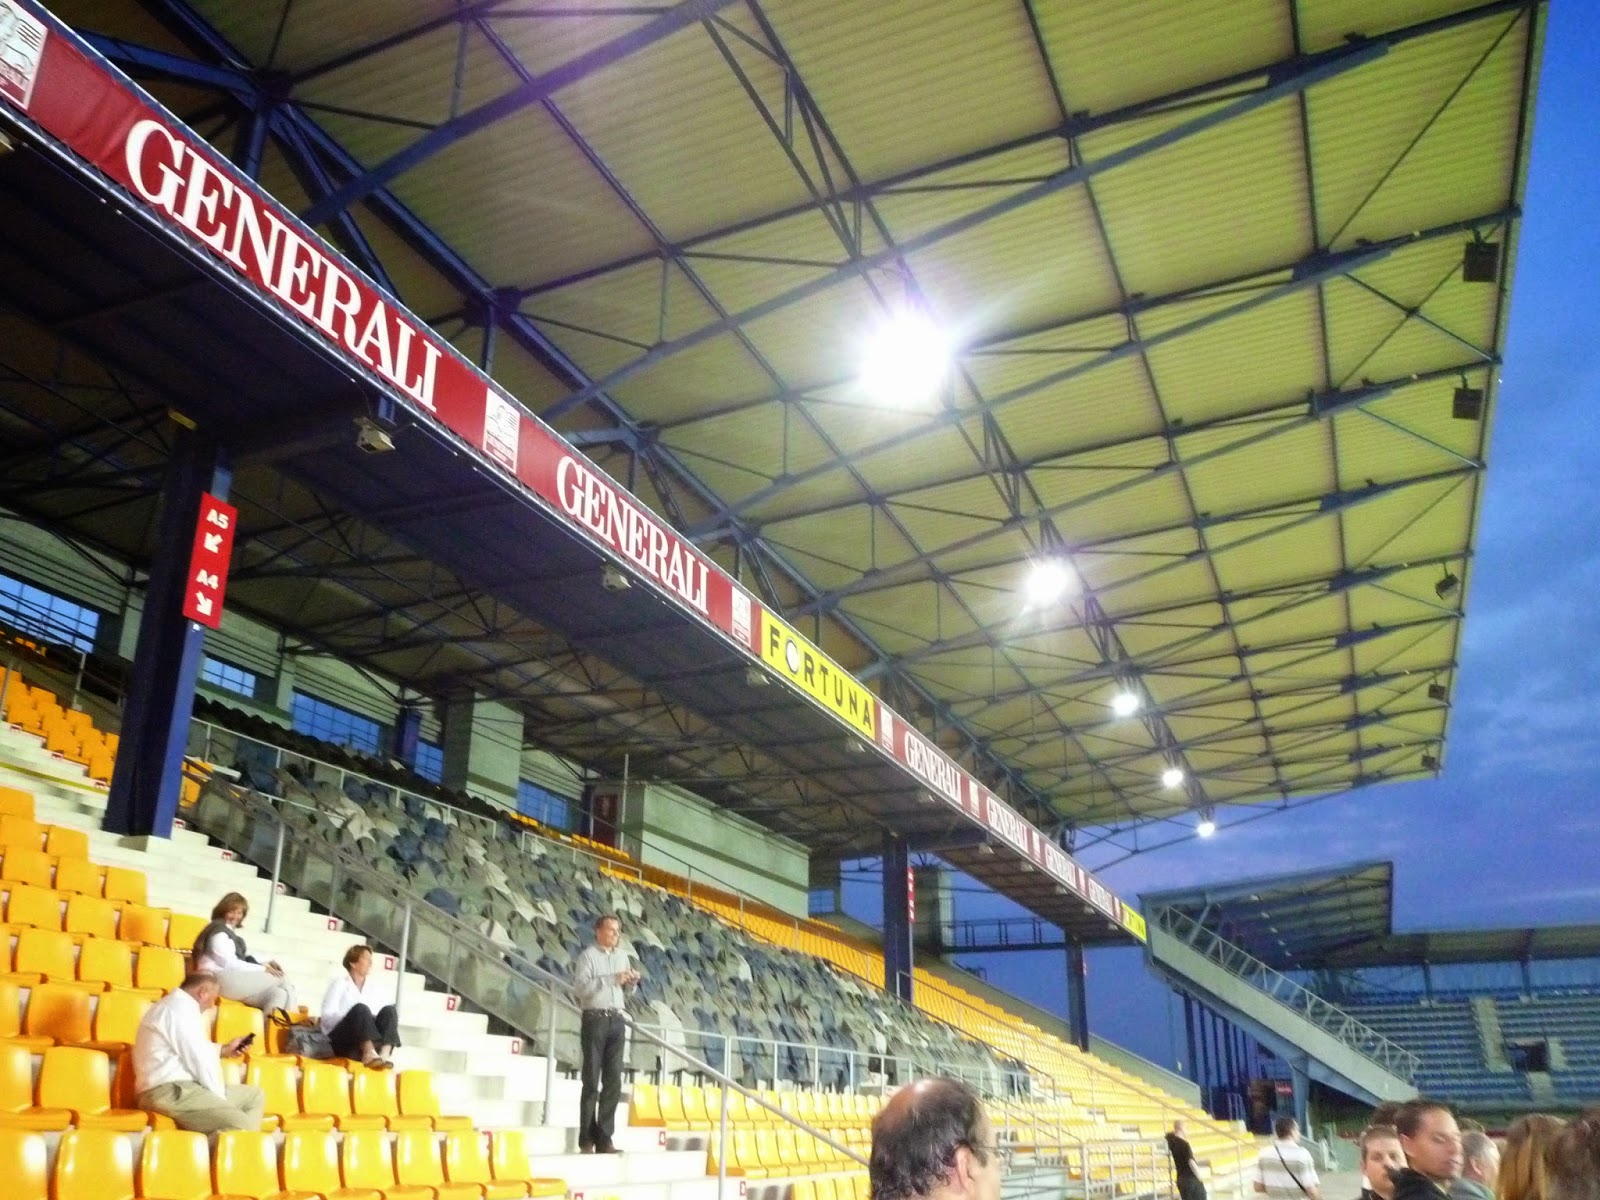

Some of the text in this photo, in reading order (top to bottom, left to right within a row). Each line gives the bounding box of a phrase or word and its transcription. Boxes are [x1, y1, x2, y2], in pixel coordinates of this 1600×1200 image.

[126, 119, 442, 414] GENERALI
[206, 508, 229, 530] A5
[556, 454, 710, 616] GENERALI
[195, 568, 219, 590] A4
[769, 623, 872, 731] FORTUNA
[904, 730, 962, 806] GENERALI
